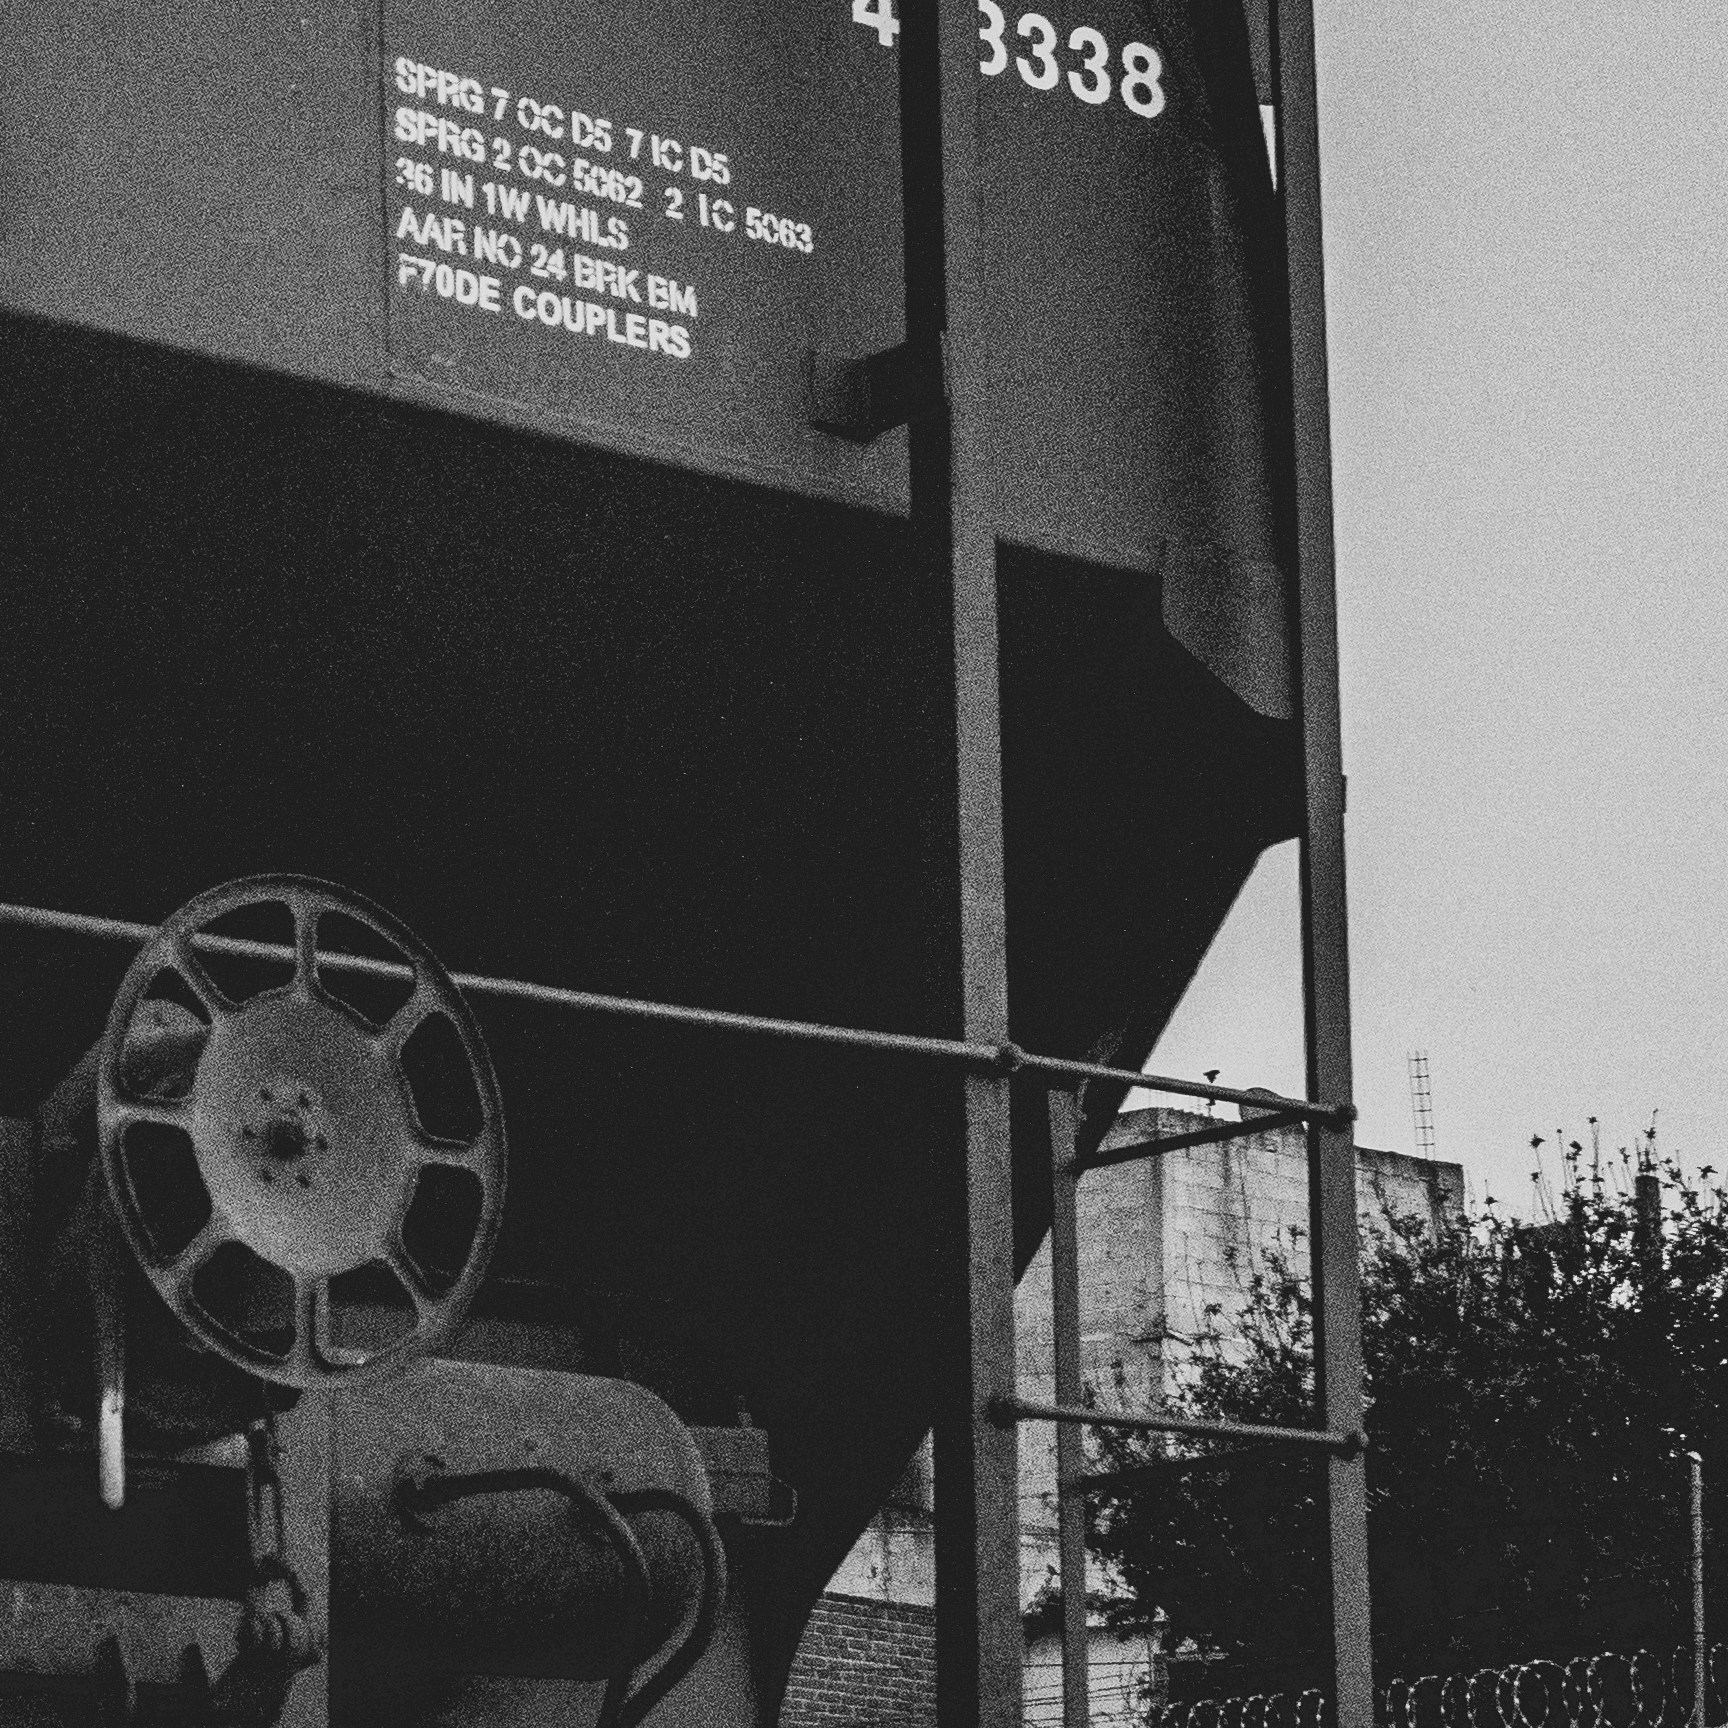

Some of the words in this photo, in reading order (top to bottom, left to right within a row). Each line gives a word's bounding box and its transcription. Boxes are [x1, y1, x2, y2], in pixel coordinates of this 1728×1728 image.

[395, 57, 484, 115] SPRG
[490, 87, 509, 121] 7
[516, 97, 564, 139] OC
[625, 127, 643, 159] 7
[394, 107, 485, 162] SPRG
[493, 137, 512, 171] 2
[518, 145, 567, 186] OC
[664, 187, 684, 220] 2
[745, 206, 815, 254] 5063
[442, 168, 474, 209] IN
[482, 181, 531, 223] 1W
[536, 194, 629, 251] WHLS
[396, 206, 467, 256] AAR
[474, 225, 522, 269] NO
[530, 244, 567, 282] 24
[575, 254, 642, 304] BRK
[513, 286, 692, 359] COUPLERS
